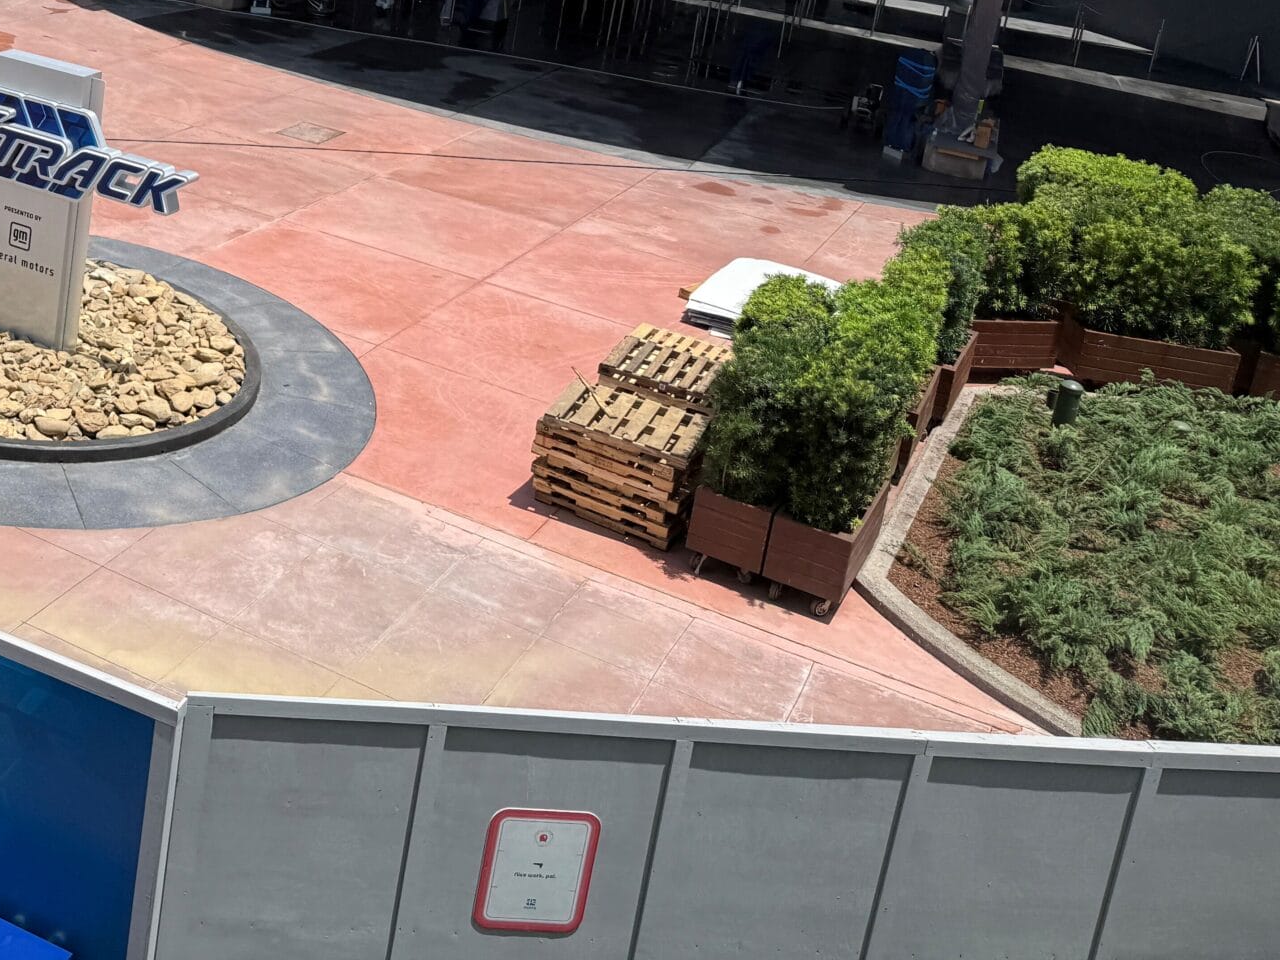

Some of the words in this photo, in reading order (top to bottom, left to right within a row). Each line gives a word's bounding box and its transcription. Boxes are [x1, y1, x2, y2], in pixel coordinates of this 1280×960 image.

[4, 205, 34, 219] PRESENTED
[13, 228, 28, 242] gm
[21, 259, 55, 277] motors
